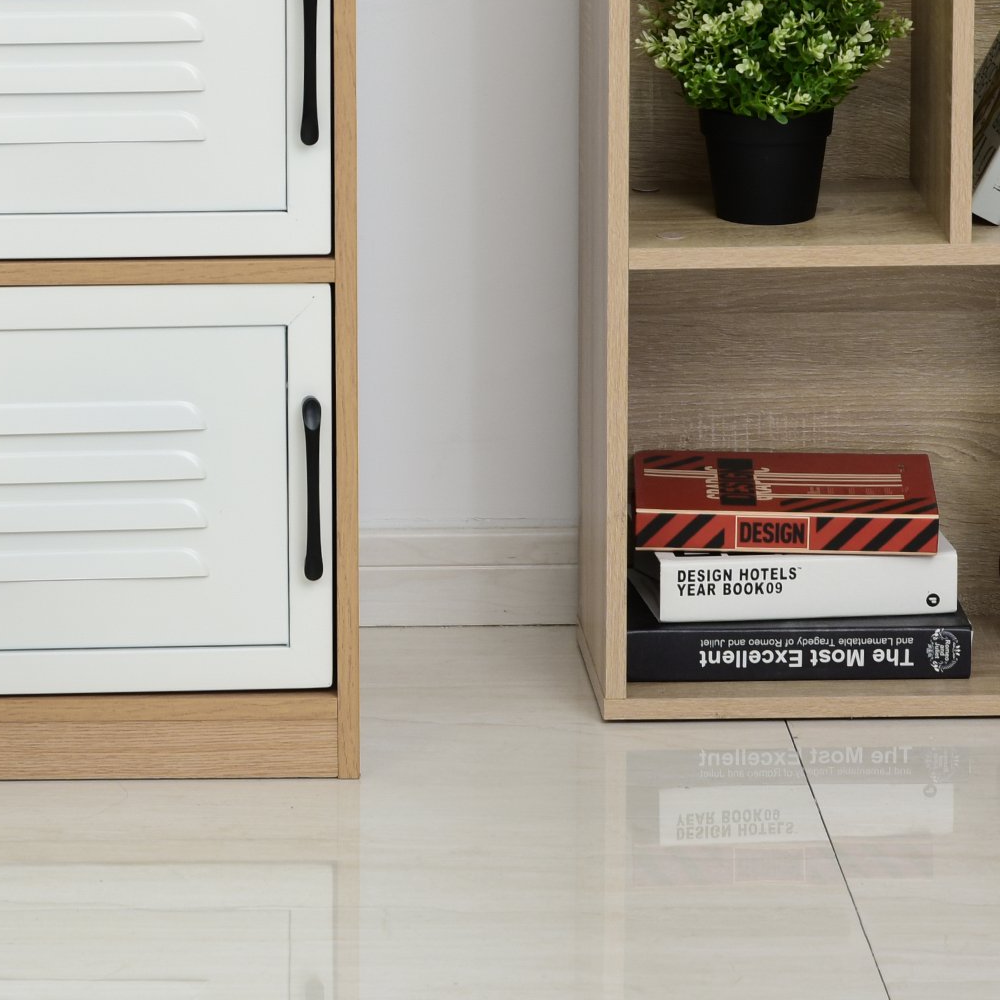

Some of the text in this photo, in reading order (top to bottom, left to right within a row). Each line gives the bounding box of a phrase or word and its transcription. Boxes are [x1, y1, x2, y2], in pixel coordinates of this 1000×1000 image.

[739, 521, 805, 544] DESIGN
[677, 568, 733, 583] DESIGN
[677, 583, 716, 596] YEAR
[699, 637, 914, 648] and Lamentable Tragedy of Romeo and Juliet
[699, 648, 915, 668] The Most Excellent
